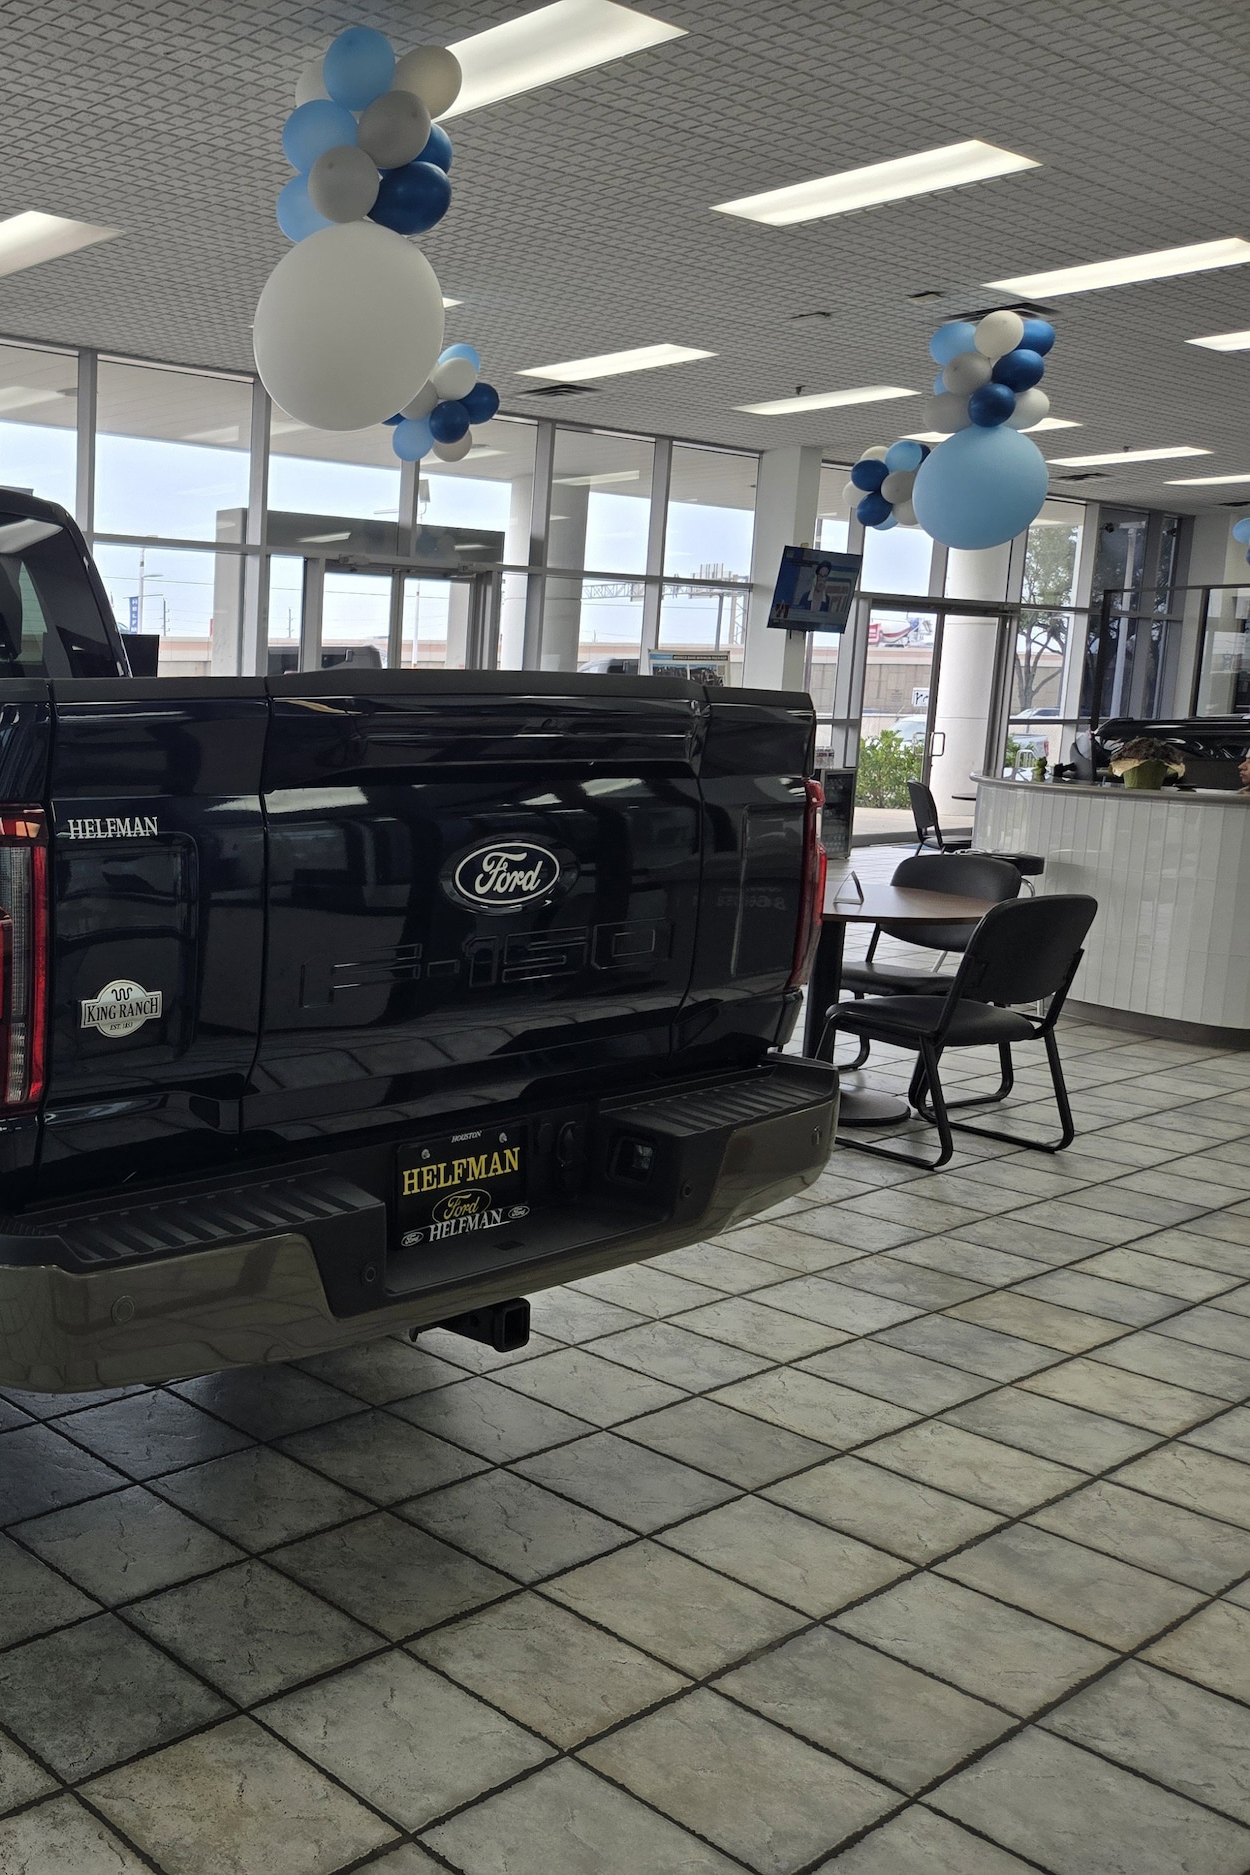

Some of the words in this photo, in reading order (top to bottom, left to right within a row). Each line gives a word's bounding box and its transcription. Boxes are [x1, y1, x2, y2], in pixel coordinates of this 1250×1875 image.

[68, 816, 158, 839] HELFMAN
[474, 852, 544, 895] Ford
[299, 917, 674, 1009] F-150
[87, 1004, 117, 1023] KING
[119, 996, 159, 1019] RANCH
[451, 1130, 482, 1143] HOUSTON
[402, 1146, 521, 1196] HELFMAN
[443, 1193, 481, 1220] Ford
[429, 1208, 503, 1242] HELFMAN
